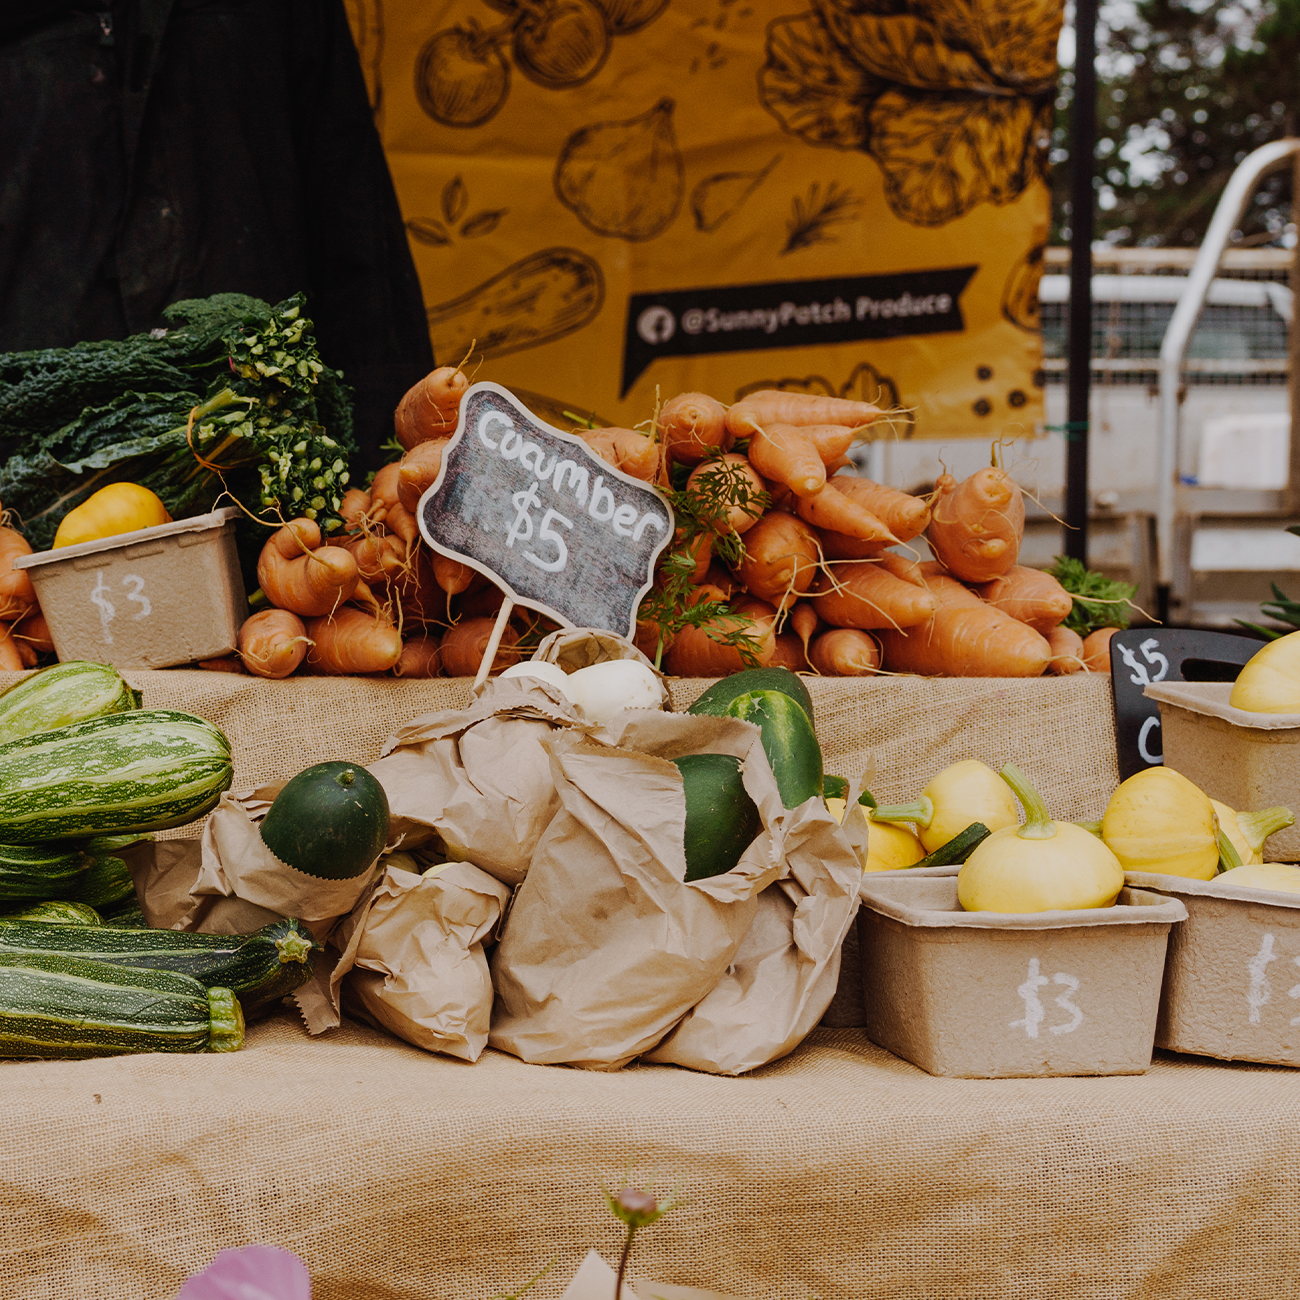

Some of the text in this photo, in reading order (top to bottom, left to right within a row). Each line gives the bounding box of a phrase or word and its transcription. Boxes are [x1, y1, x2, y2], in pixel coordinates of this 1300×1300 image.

[680, 291, 953, 335] @SunnyPatch Produce
[477, 410, 665, 542] Cucumber
[505, 481, 574, 573] $5
[90, 570, 152, 645] $3
[1116, 637, 1170, 686] $5
[1008, 957, 1084, 1038] $3
